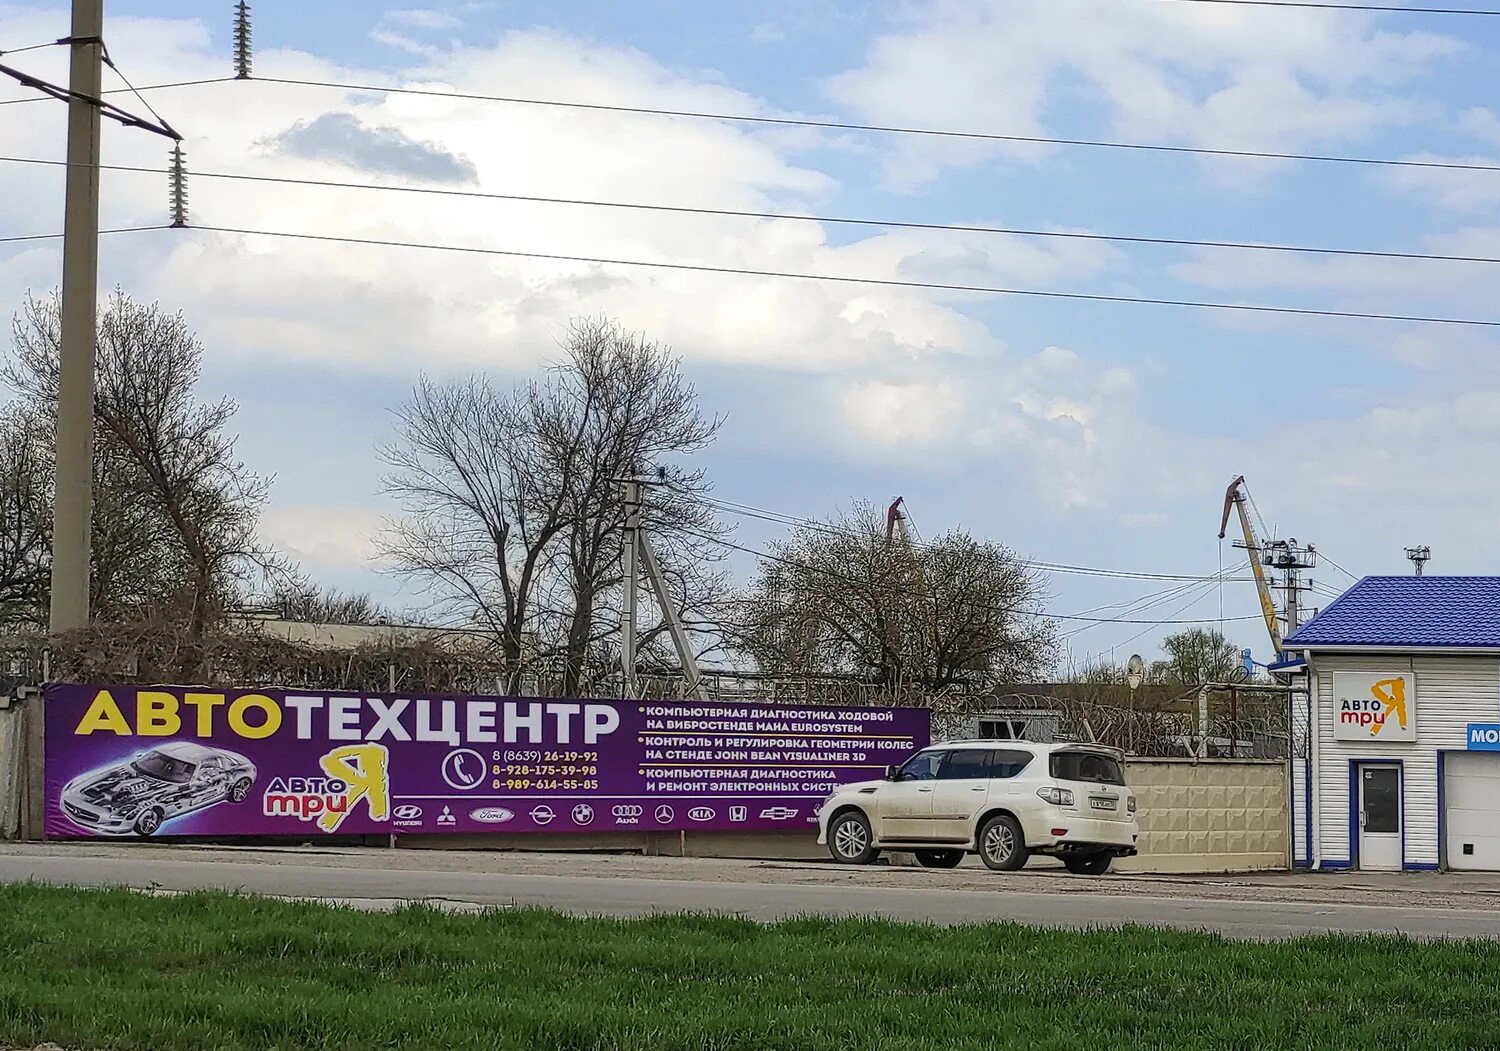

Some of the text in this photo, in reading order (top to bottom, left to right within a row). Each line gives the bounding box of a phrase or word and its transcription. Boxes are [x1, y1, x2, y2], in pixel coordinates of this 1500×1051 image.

[1341, 699, 1381, 711] АВТО
[74, 690, 621, 746] АВТОТЕХЦЕНТР
[646, 706, 893, 721] КОМПЬЮТЕРНАЯ ДИАГНОСТИКА ХОДОВОЙ
[1341, 711, 1385, 727] три
[646, 719, 664, 729] НА
[666, 720, 754, 731] ВИБРОСТЕНДЕ
[791, 723, 863, 733] EUROSYSTEM
[645, 736, 914, 750] КОНТРОЛЬ И РЕГУЛИРОВКА ГЕОМЕТРИИ КОЛЕС
[492, 749, 598, 763] 8 (8639) 26-19-92
[645, 750, 867, 761] НА СТЕНДЕ JOHN BEAN VISUALINER 3D
[492, 765, 597, 776] 8-928-175-39-98
[646, 768, 837, 780] КОМПЬЮТЕРНАЯ ДИАГНОСТИКА
[267, 778, 348, 794] АВТО
[492, 779, 598, 790] 8-989-614-55-85
[646, 781, 846, 792] И РЕМОНТ ЭЛЕКТРОННЫХ СИСТЕ
[265, 795, 348, 818] три
[615, 816, 639, 825] Audi
